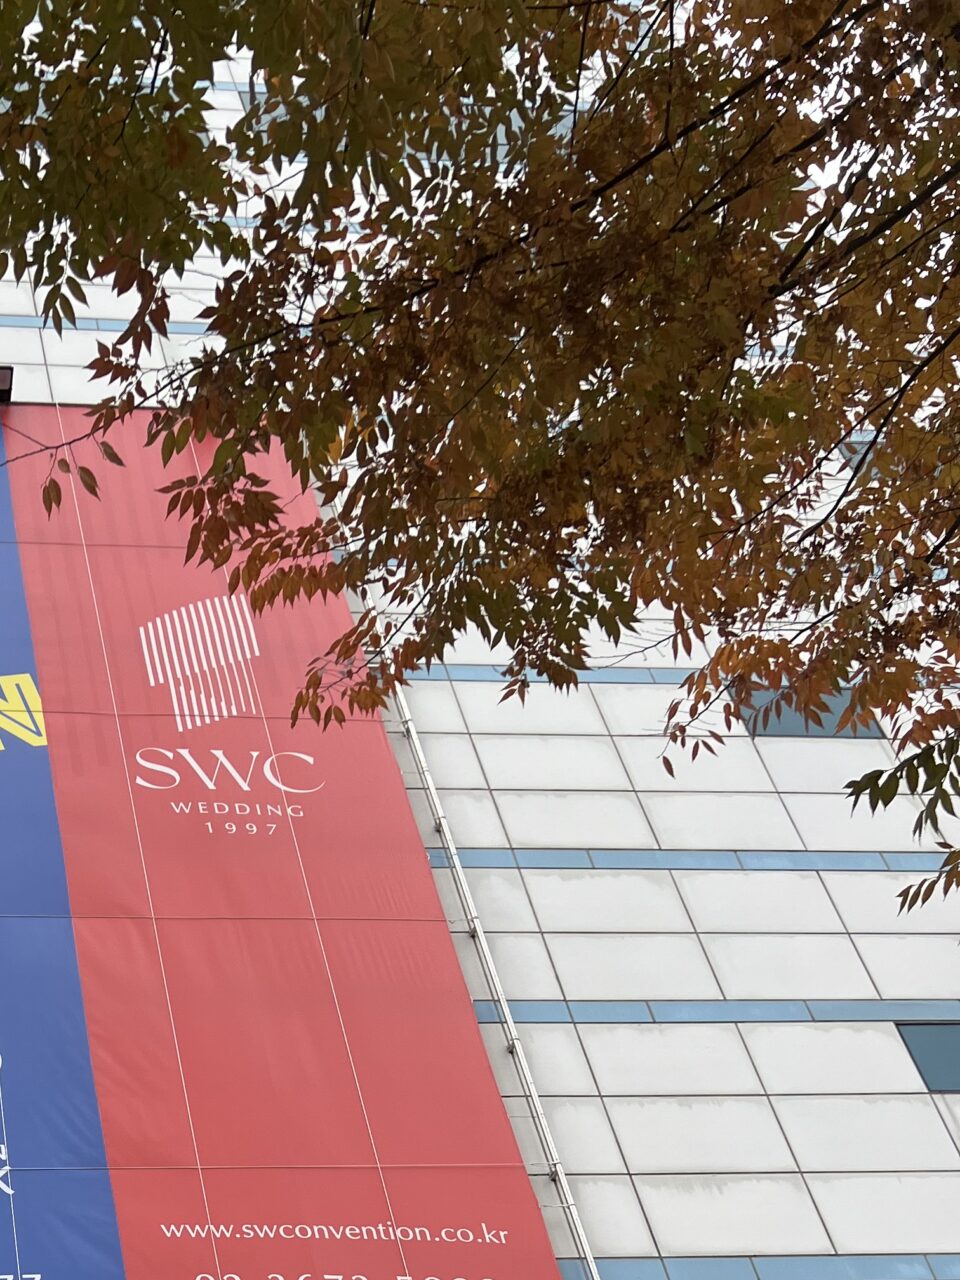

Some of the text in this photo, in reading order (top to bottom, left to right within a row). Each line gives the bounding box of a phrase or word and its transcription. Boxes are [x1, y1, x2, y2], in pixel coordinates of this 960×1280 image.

[135, 747, 326, 794] SWC
[170, 802, 304, 817] WEDDING
[204, 821, 278, 835] 1997
[160, 1221, 509, 1244] www.swconvention.co.kr
